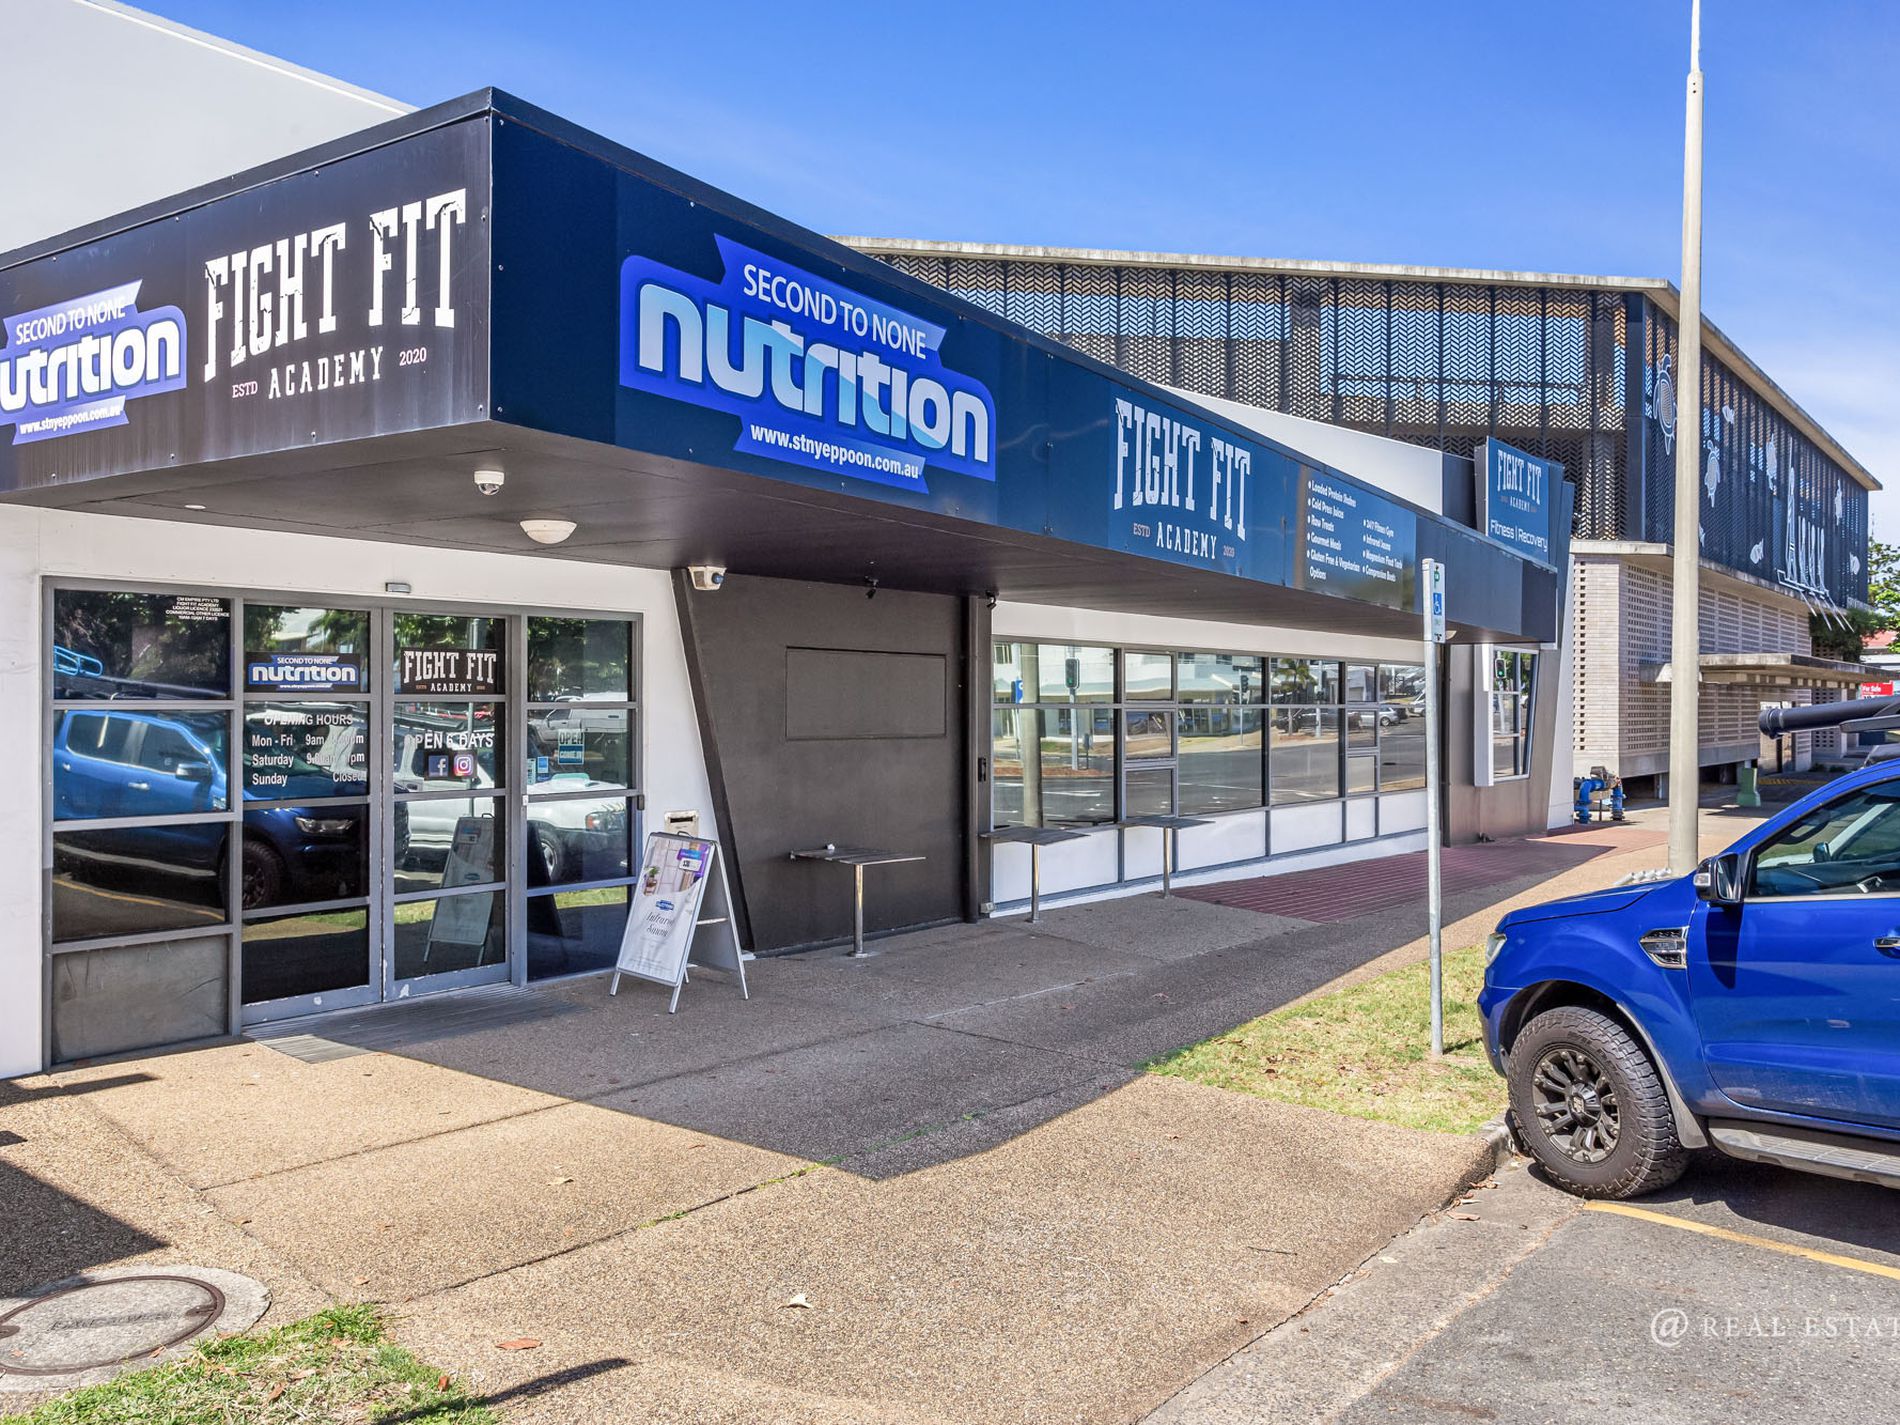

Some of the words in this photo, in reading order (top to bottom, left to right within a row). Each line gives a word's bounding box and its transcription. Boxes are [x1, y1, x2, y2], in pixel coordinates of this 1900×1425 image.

[204, 222, 346, 383] FIGHT
[369, 188, 466, 328] FIT
[743, 263, 837, 325] SECOND
[840, 299, 868, 336] TO
[873, 313, 926, 360] NONE
[16, 312, 66, 345] SECOND
[68, 307, 85, 331] TO
[87, 298, 126, 327] NONE
[232, 381, 258, 399] ESTD
[268, 346, 383, 399] ACADEMY
[400, 347, 427, 366] 2020
[639, 283, 989, 463] nutrition
[20, 406, 121, 435] www.stnyeppoon.com.au
[750, 424, 919, 480] www.stnyeppoon.com.au
[1114, 398, 1200, 511] FIGHT
[1210, 437, 1250, 541] FIT
[1497, 449, 1524, 492] FIGHT
[1527, 461, 1542, 505] FIT
[1312, 480, 1328, 496] Loaded
[1328, 487, 1342, 502] Protein
[1311, 497, 1321, 510] Cold
[1510, 496, 1530, 512] ACADEMY
[1322, 518, 1334, 532] Treats
[1133, 523, 1150, 537] ESTD
[1156, 522, 1217, 559] ACADEMY
[1223, 545, 1235, 558] 2020
[1311, 532, 1329, 547] Gourmet
[1490, 519, 1515, 539] Fitness
[1518, 529, 1548, 552] Recovery
[1311, 549, 1325, 563] Gluten
[1326, 553, 1334, 565] Free
[1335, 556, 1339, 566] &
[1339, 557, 1360, 572] Vegetarian
[1310, 566, 1326, 580] Options
[277, 657, 303, 665] SECOND
[403, 650, 459, 683] FIGHT
[466, 652, 497, 683] FIT
[252, 665, 356, 682] nutrition
[430, 683, 472, 692] ACADEMY
[316, 714, 353, 725] HOURS
[252, 734, 272, 746] Mon
[280, 733, 293, 746] Fri
[305, 734, 325, 745] 9am
[446, 732, 455, 749] 6
[459, 732, 494, 749] DAYS
[560, 732, 583, 744] OPEN
[252, 754, 294, 767] Saturday
[252, 773, 288, 787] Sunday
